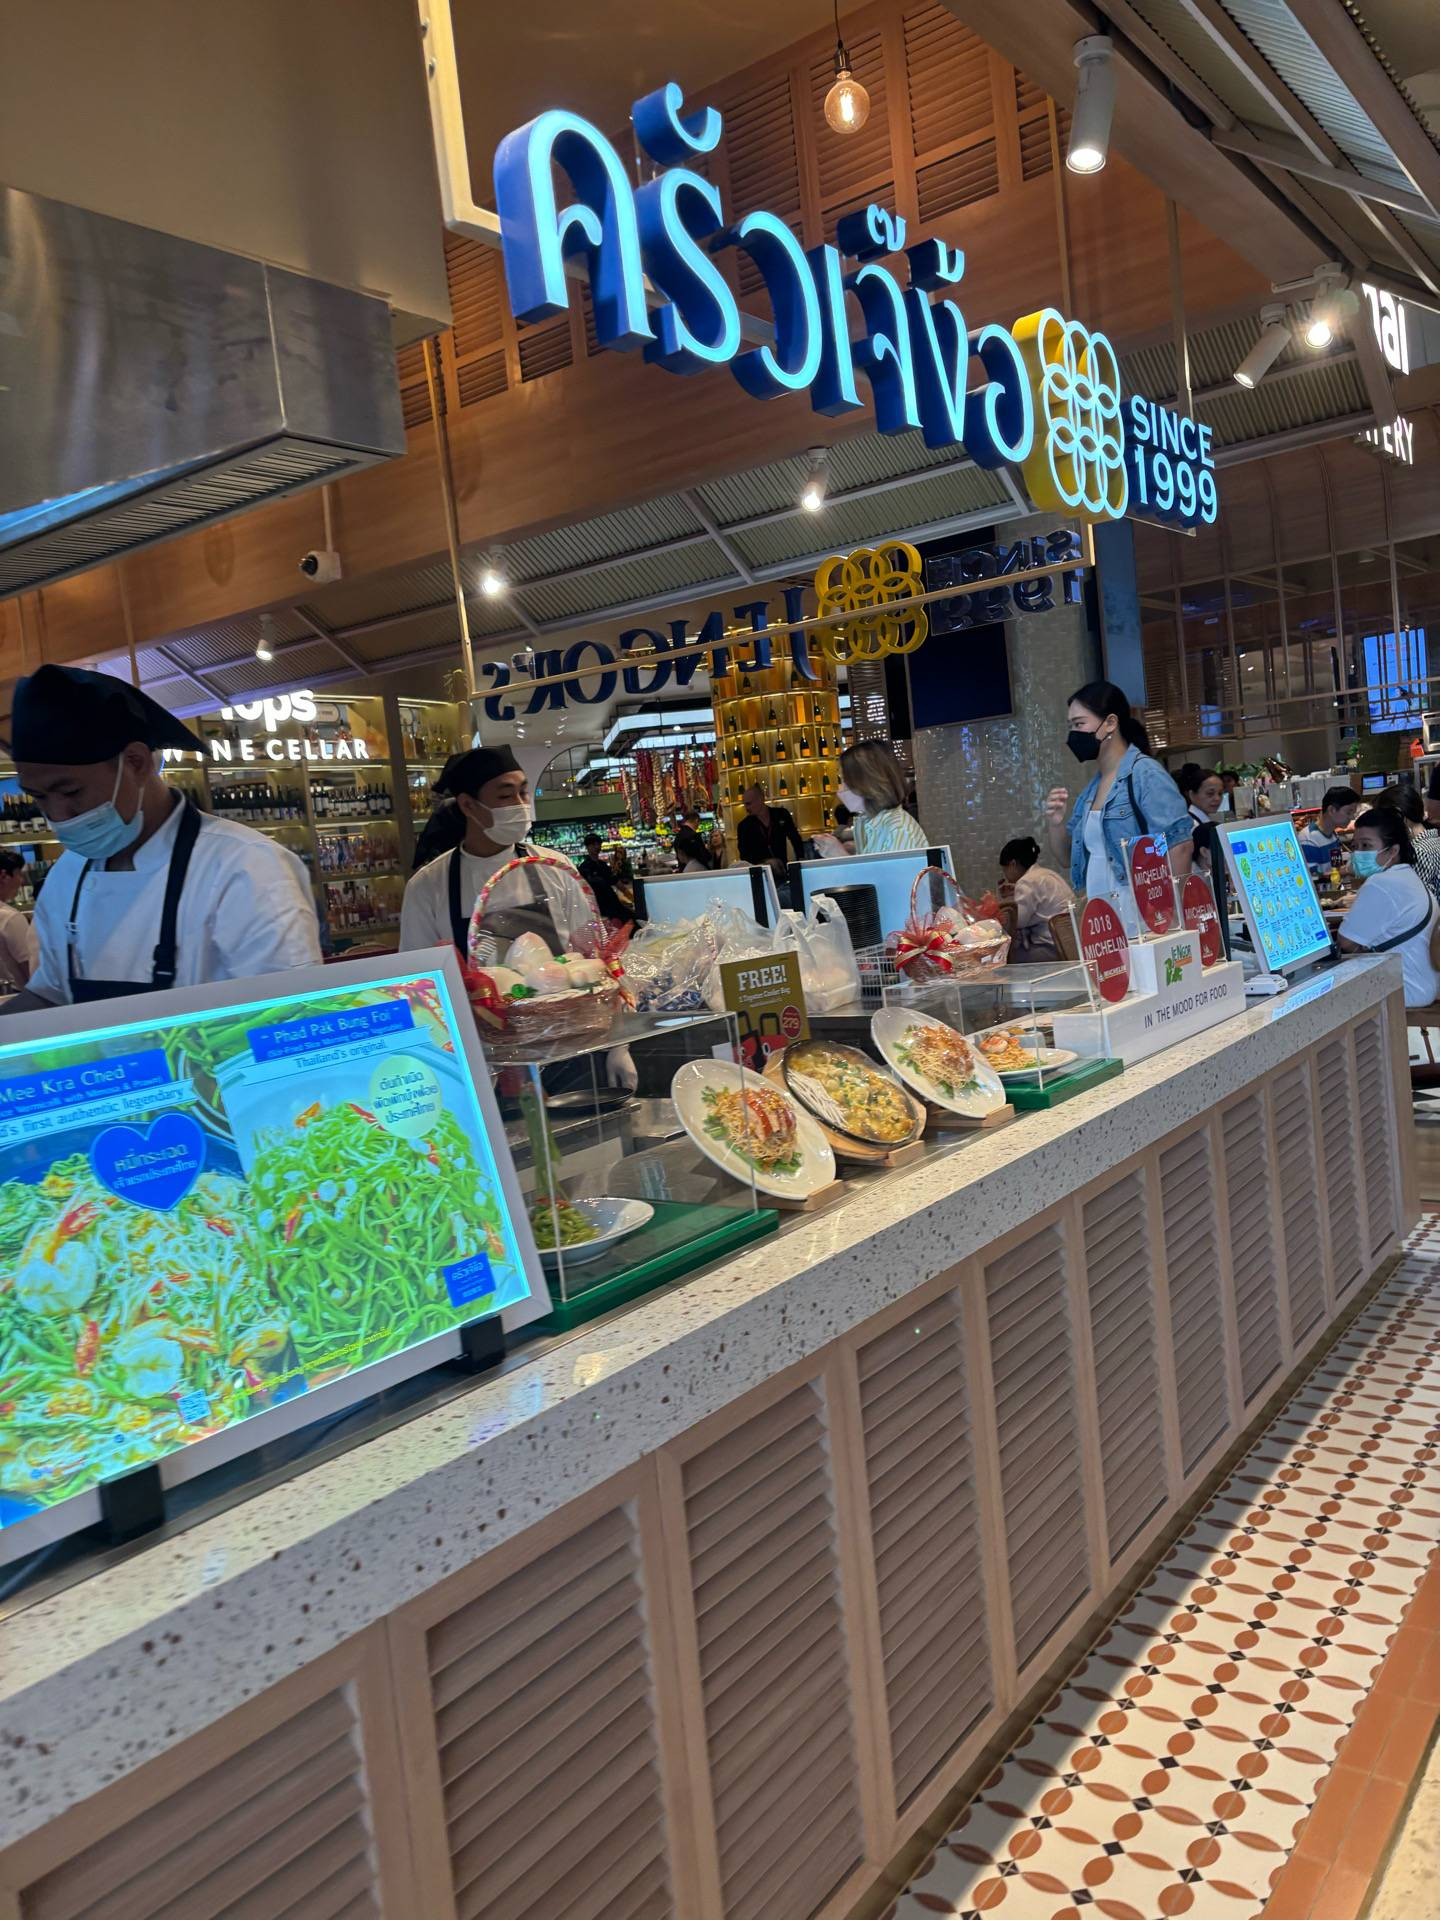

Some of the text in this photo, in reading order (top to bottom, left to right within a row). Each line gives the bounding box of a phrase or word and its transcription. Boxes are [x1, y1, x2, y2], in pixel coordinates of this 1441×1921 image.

[494, 82, 1034, 468] ครัวเจ๊ง้อ
[1130, 395, 1215, 469] SINCE
[1134, 444, 1217, 525] 1999
[266, 739, 370, 761] CELLAR
[1134, 866, 1168, 886] MICHELIN
[1147, 886, 1163, 900] 2020
[1088, 915, 1112, 935] 2018
[1084, 936, 1127, 960] MICHELIN
[737, 964, 787, 992] FREE!
[1144, 984, 1227, 1029] IN THE MOOD FOR FOOD
[274, 1027, 306, 1043] Phad
[311, 1022, 334, 1038] Pak
[337, 1016, 369, 1034] Bung
[295, 1050, 348, 1069] Thailand's
[41, 1077, 75, 1095] Kra
[81, 1066, 125, 1085] Ched
[24, 1116, 53, 1132] first
[57, 1101, 119, 1124] authentic
[123, 1087, 185, 1110] legendary
